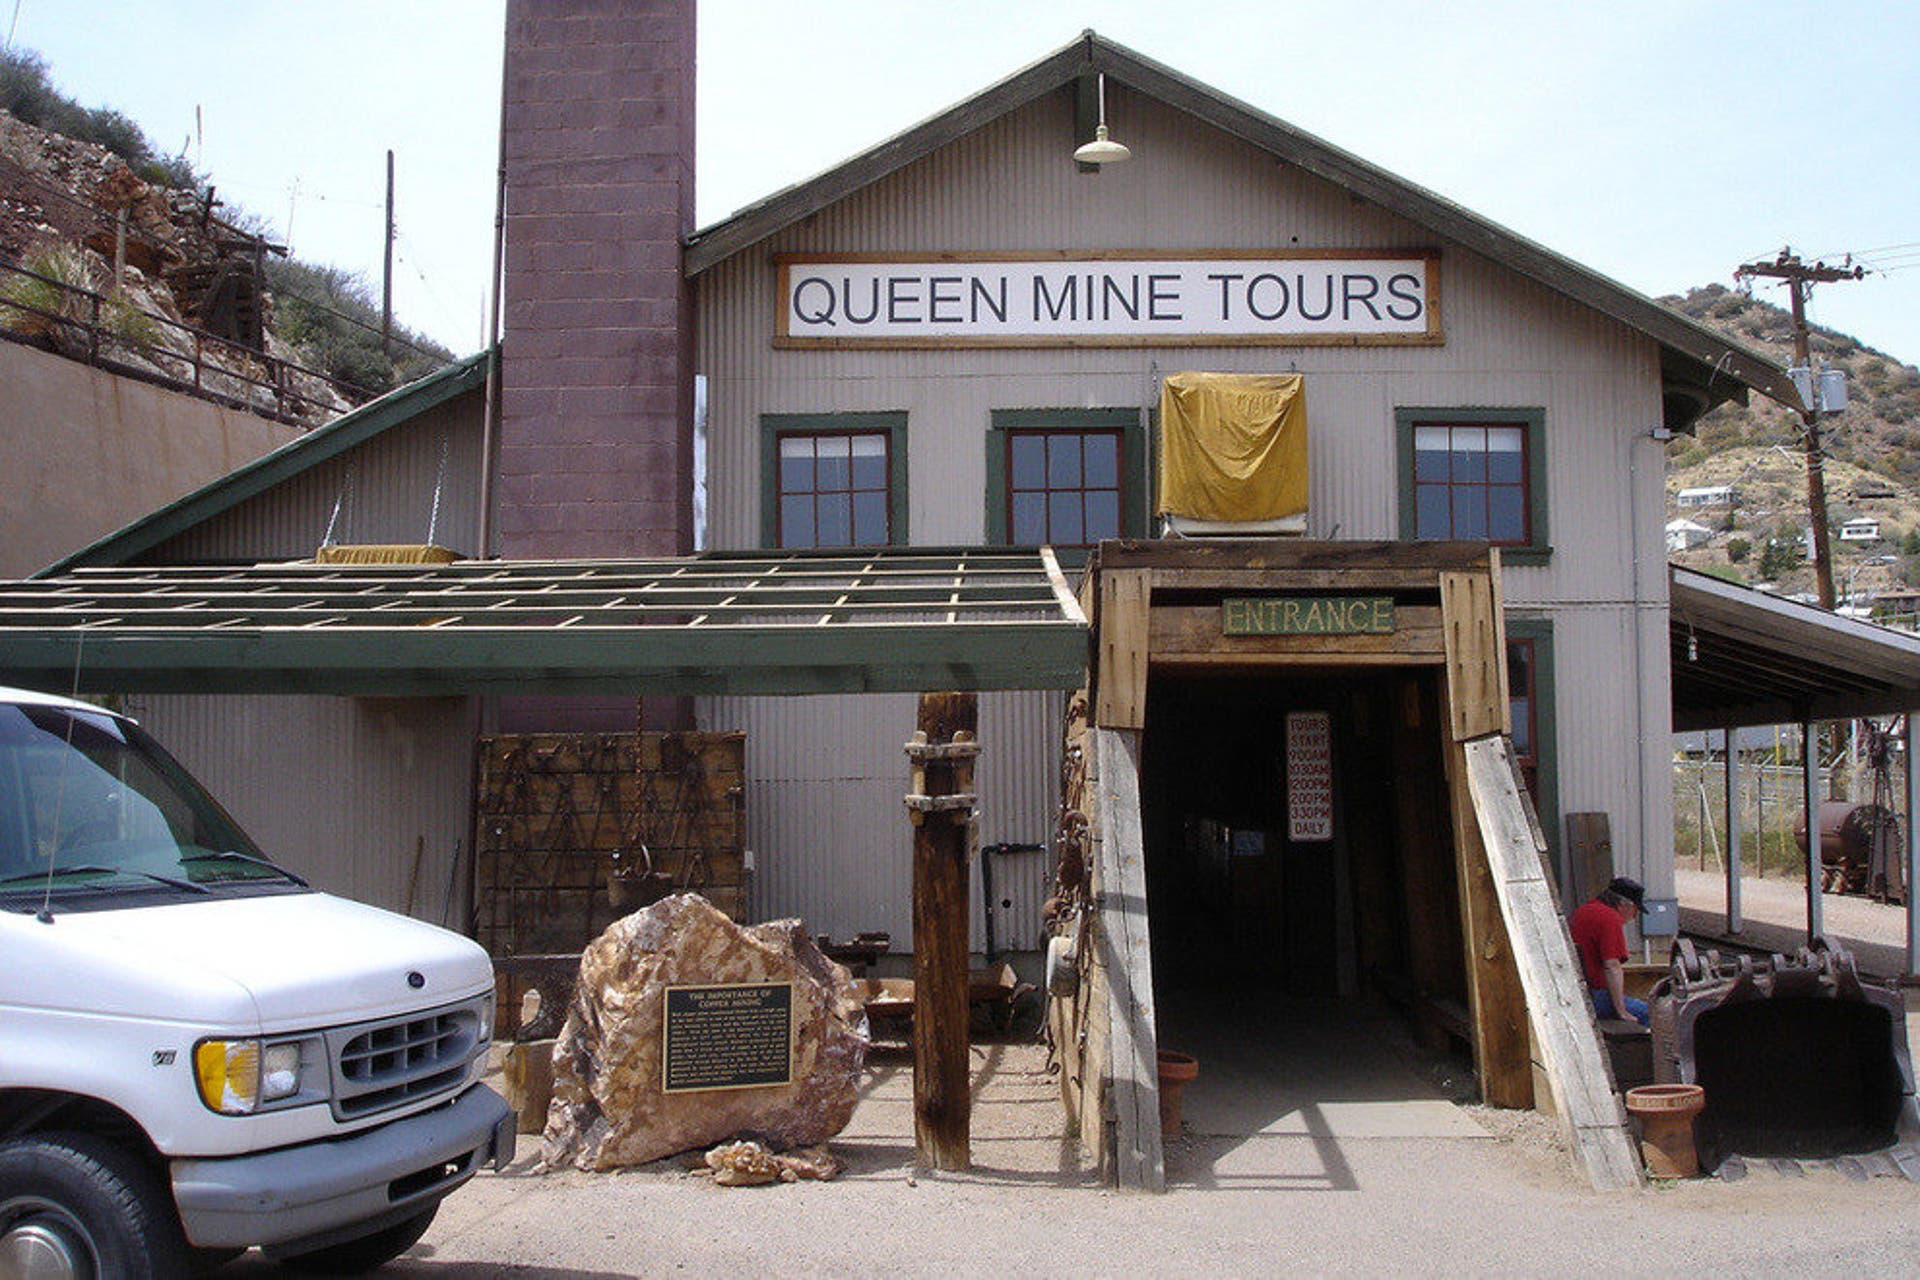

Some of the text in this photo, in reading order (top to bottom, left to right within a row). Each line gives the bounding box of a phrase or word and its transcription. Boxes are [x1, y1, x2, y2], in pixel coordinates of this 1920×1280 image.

[793, 273, 1424, 327] QUEEN MINE TOURS
[1227, 601, 1391, 632] ENTRANCE
[1290, 718, 1329, 731] TOURS
[1290, 734, 1327, 747] START
[1294, 822, 1325, 834] DAILY
